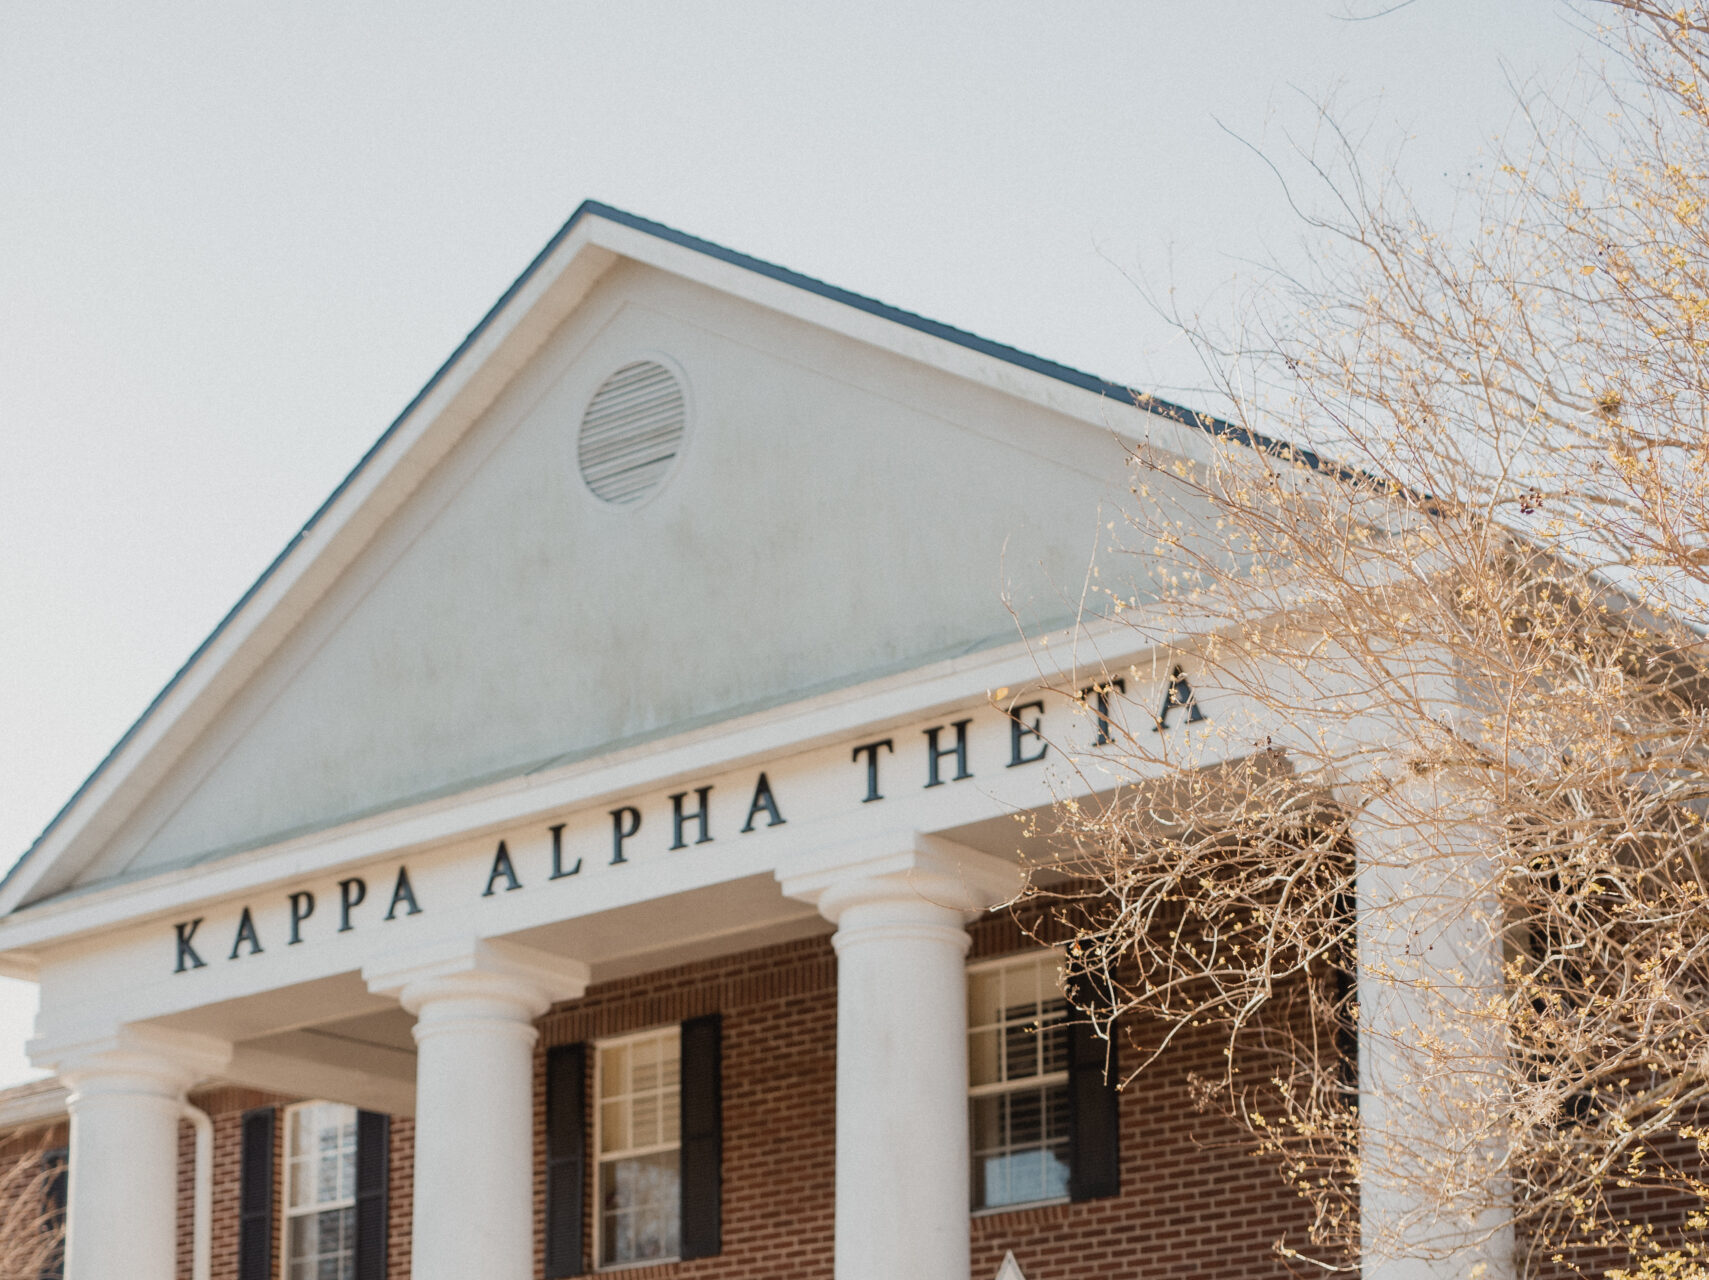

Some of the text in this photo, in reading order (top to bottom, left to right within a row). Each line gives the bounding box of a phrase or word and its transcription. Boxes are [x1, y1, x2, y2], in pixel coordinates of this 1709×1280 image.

[173, 664, 1208, 974] KAPPA ALPHA THETA
